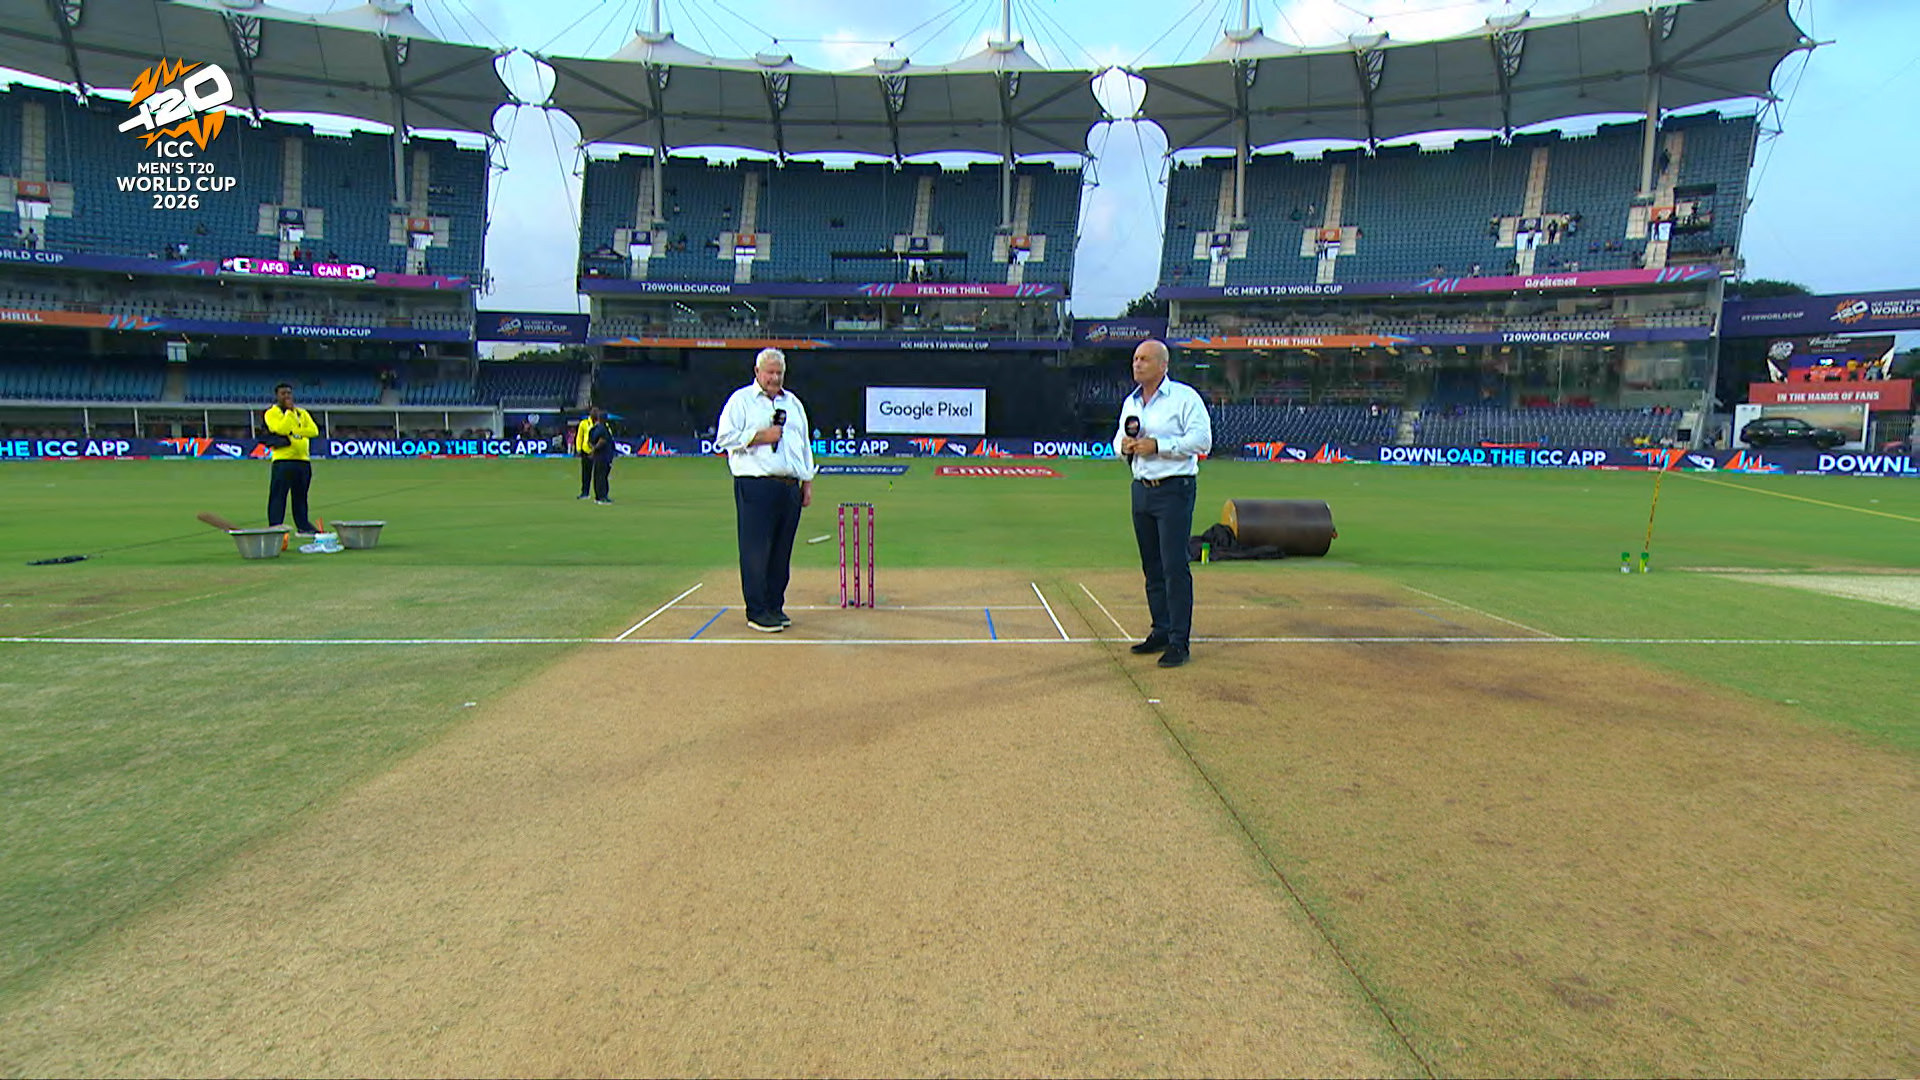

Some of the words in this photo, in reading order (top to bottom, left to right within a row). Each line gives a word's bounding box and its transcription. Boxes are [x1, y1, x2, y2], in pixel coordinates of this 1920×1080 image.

[35, 252, 64, 263] CUP
[261, 262, 285, 273] AFG
[318, 266, 342, 277] CAN
[641, 283, 731, 294] T20WORLDCUP.COM
[917, 286, 940, 295] FEEL
[941, 287, 958, 295] THE
[959, 287, 990, 295] THRILL
[1223, 287, 1239, 296] ICC
[1241, 286, 1269, 296] MEN'S
[1270, 286, 1287, 295] T20
[1288, 285, 1321, 295] WORLD
[1323, 285, 1343, 294] CUP
[1871, 305, 1915, 315] WORLD
[281, 325, 372, 337] #T20WORLDCUP
[1503, 331, 1610, 342] T20WORLDCUP.COM
[1247, 338, 1270, 346] FEEL
[1271, 338, 1289, 346] THE
[1291, 337, 1324, 346] THRILL
[1777, 393, 1788, 402] IN
[1789, 393, 1806, 402] THE
[1807, 392, 1840, 401] HANDS
[1841, 391, 1855, 400] OF
[1855, 391, 1880, 400] FANS
[879, 401, 934, 420] Google
[938, 402, 973, 417] Pixel
[37, 440, 79, 456] ICC
[84, 440, 131, 456] APP
[330, 440, 441, 455] DOWNLOAD
[447, 440, 478, 454] THE
[483, 440, 512, 454] ICC
[515, 440, 548, 454] APP
[810, 441, 827, 453] HE
[830, 440, 856, 454] ICC
[859, 440, 889, 454] APP
[1033, 441, 1114, 456] DOWNLOA
[1380, 447, 1486, 463] DOWNLOAD
[1490, 449, 1526, 464] THE
[1530, 450, 1563, 465] ICC
[1567, 450, 1607, 466] APP
[1818, 454, 1918, 472] DOWNL
